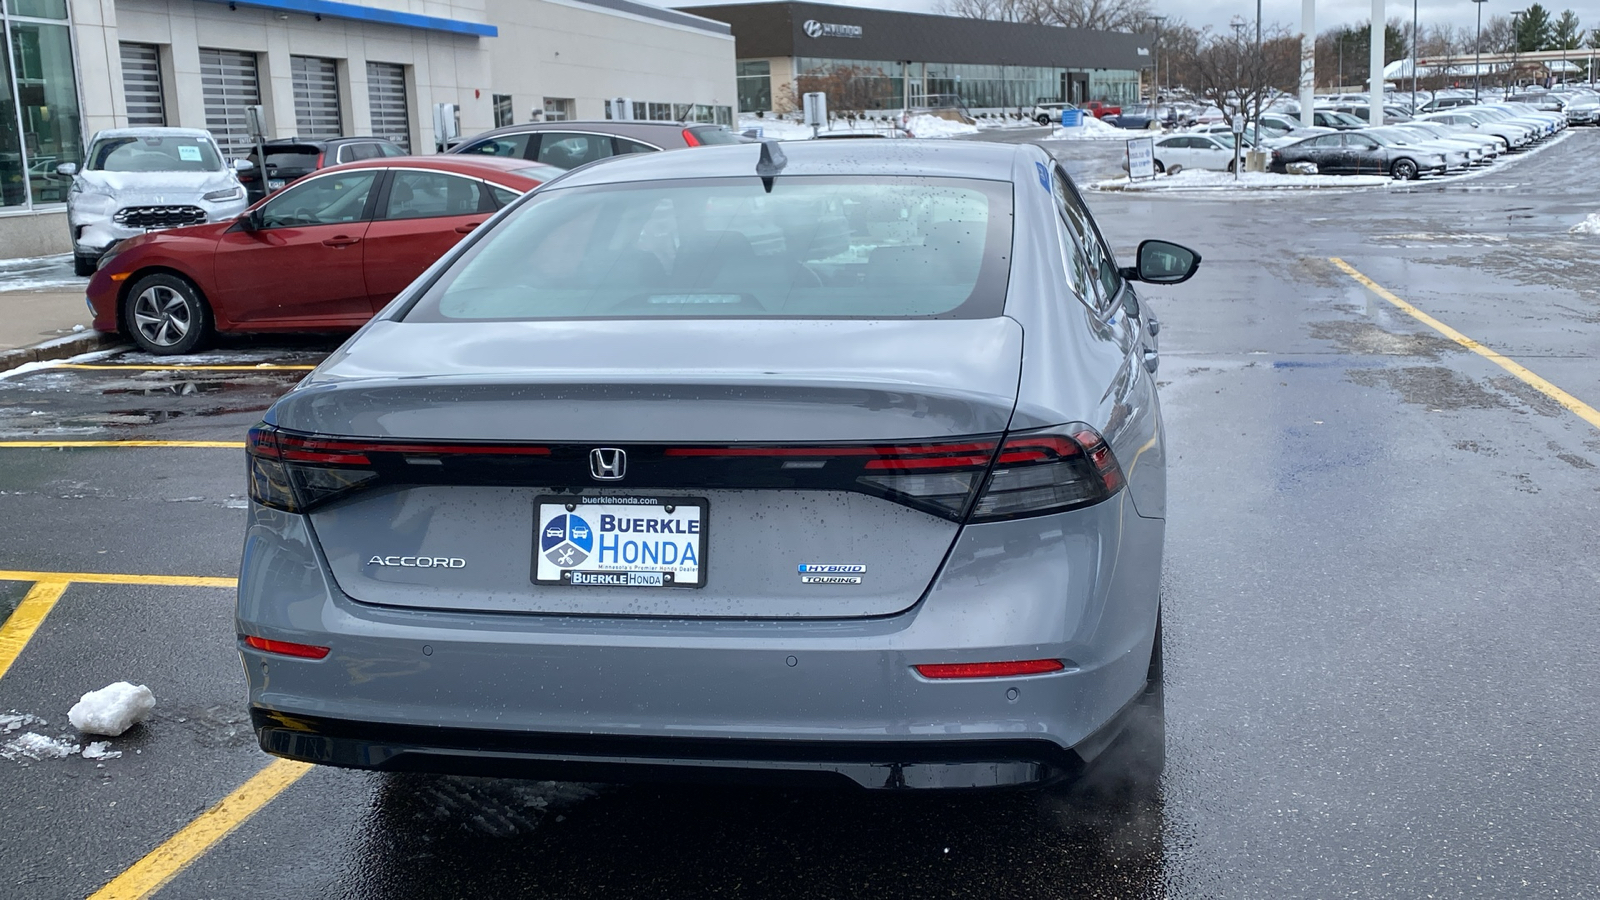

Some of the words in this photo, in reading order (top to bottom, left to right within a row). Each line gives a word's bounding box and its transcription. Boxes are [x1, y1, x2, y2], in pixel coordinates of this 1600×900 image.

[582, 496, 658, 505] buerklehonda.com
[600, 514, 699, 534] BUERKLE
[598, 534, 698, 566] HONDA
[367, 555, 466, 568] ACCORD
